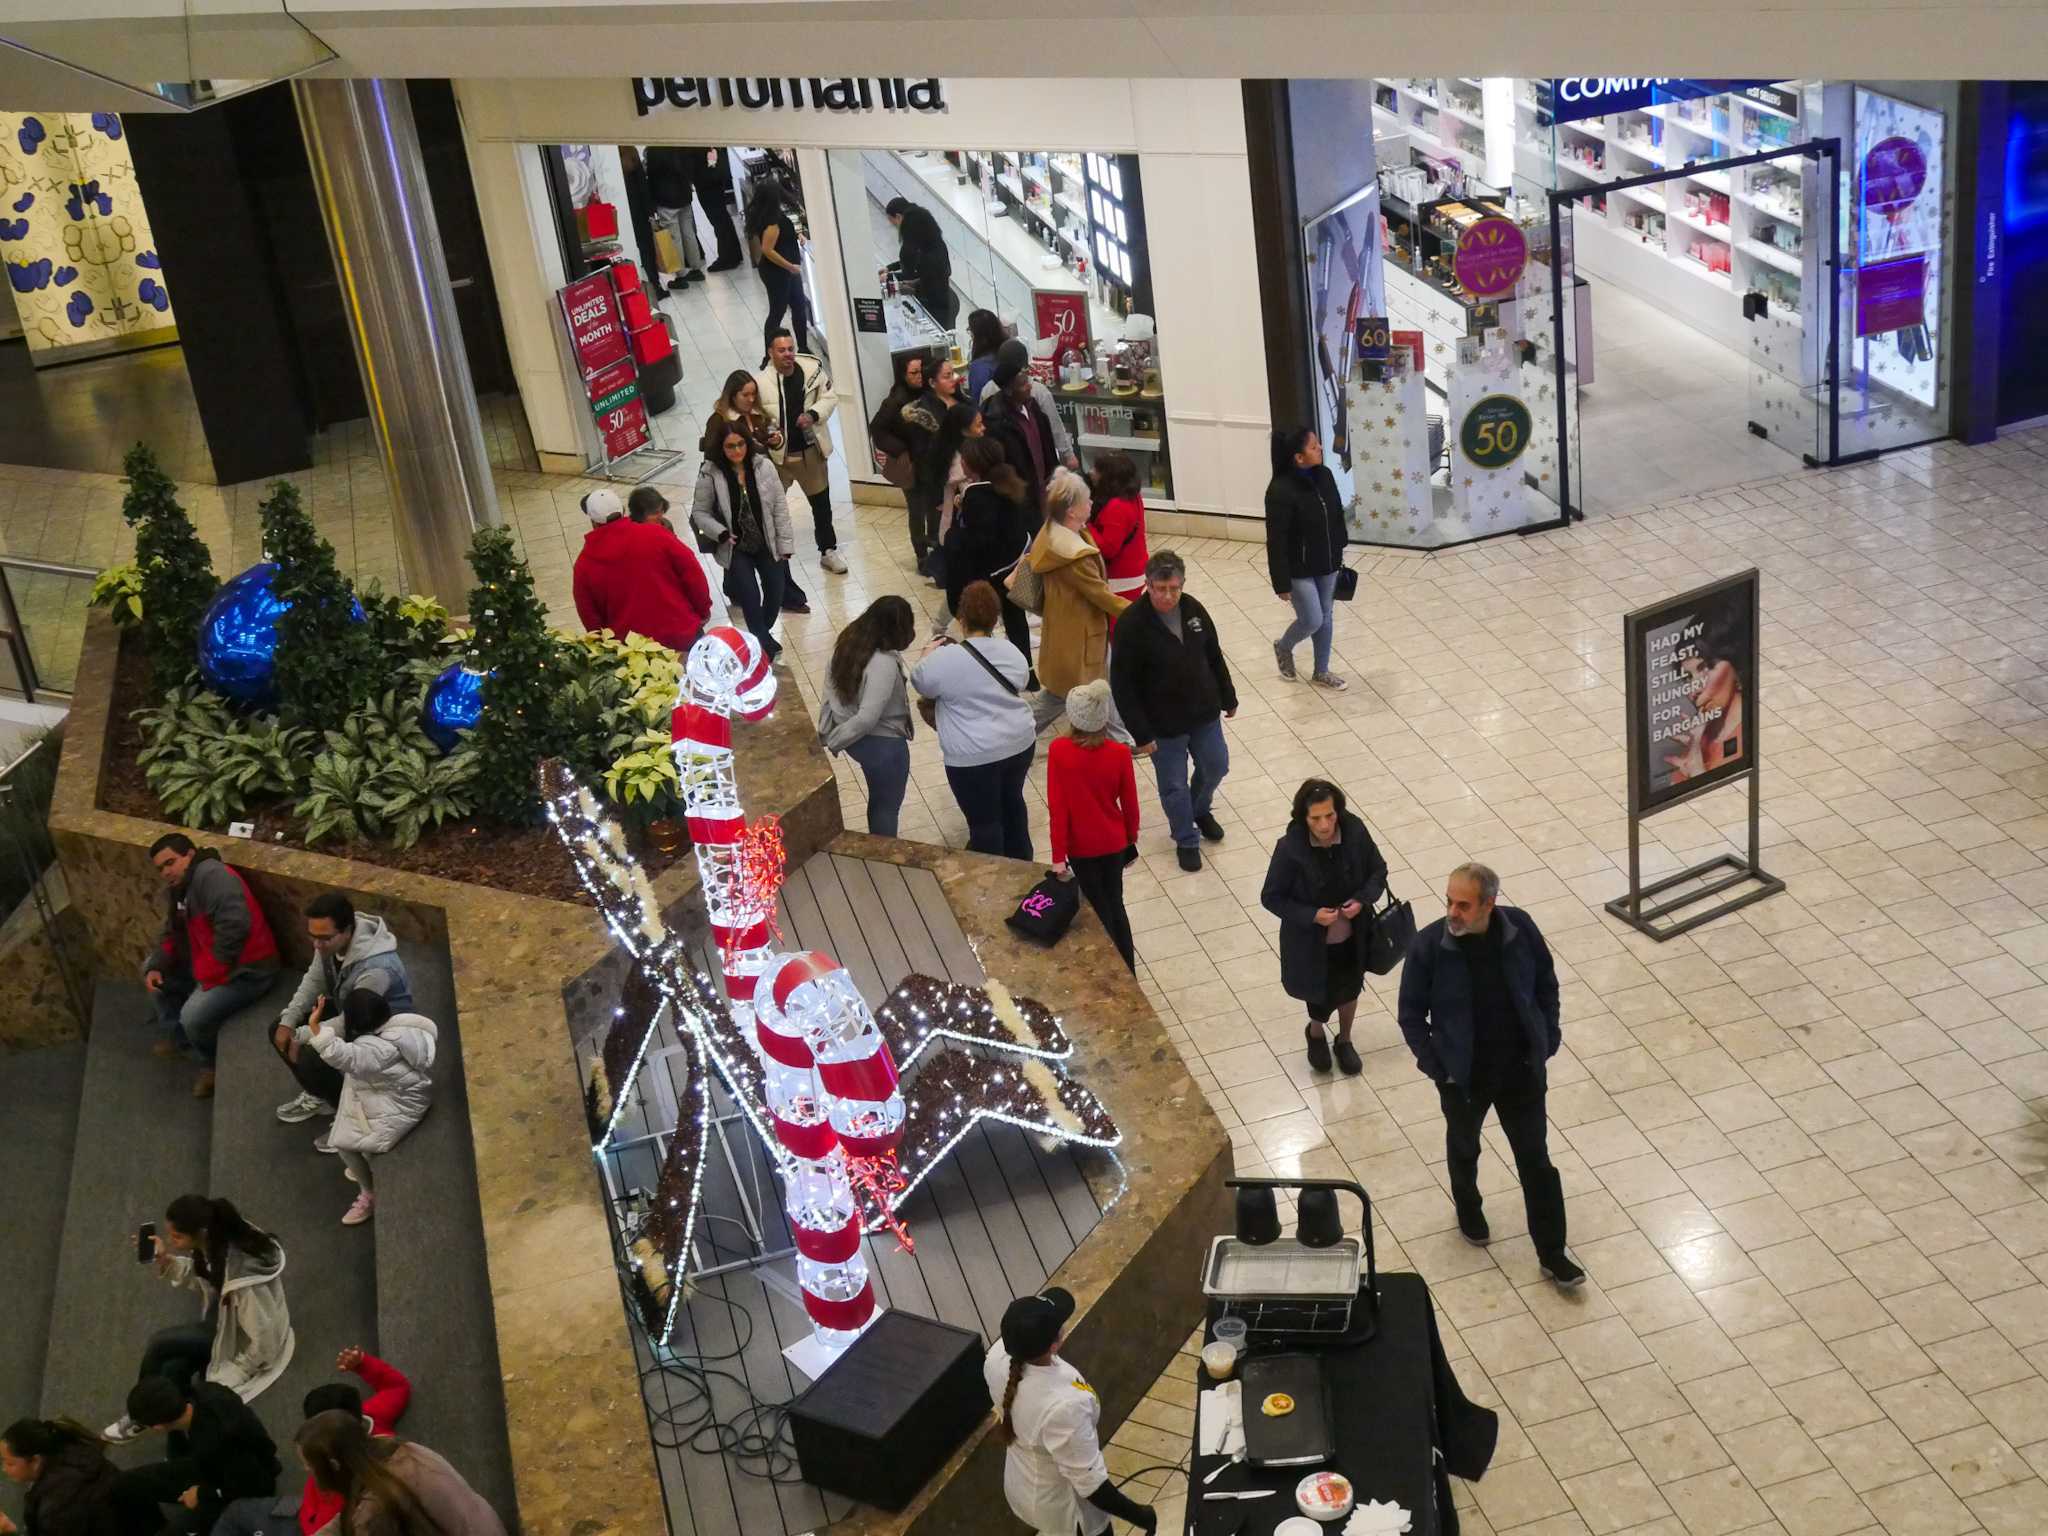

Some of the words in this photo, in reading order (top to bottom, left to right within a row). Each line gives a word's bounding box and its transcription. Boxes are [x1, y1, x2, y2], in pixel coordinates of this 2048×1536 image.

[1987, 262, 1995, 277] Fire
[571, 295, 605, 316] UNLIMITED
[573, 303, 608, 327] DEALS
[579, 322, 613, 347] MONTH
[1050, 309, 1075, 337] 50
[1361, 328, 1387, 348] 60
[594, 385, 636, 412] UNLIMITED
[1055, 401, 1134, 420] erfumania
[609, 409, 624, 433] 50
[1474, 420, 1518, 456] 50
[1650, 632, 1680, 653] HAD
[1683, 622, 1705, 641] MY
[1651, 666, 1689, 689] STILL
[1652, 675, 1709, 707] HUNGRY
[1652, 705, 1681, 725] FOR
[1653, 706, 1723, 742] BARGAINS
